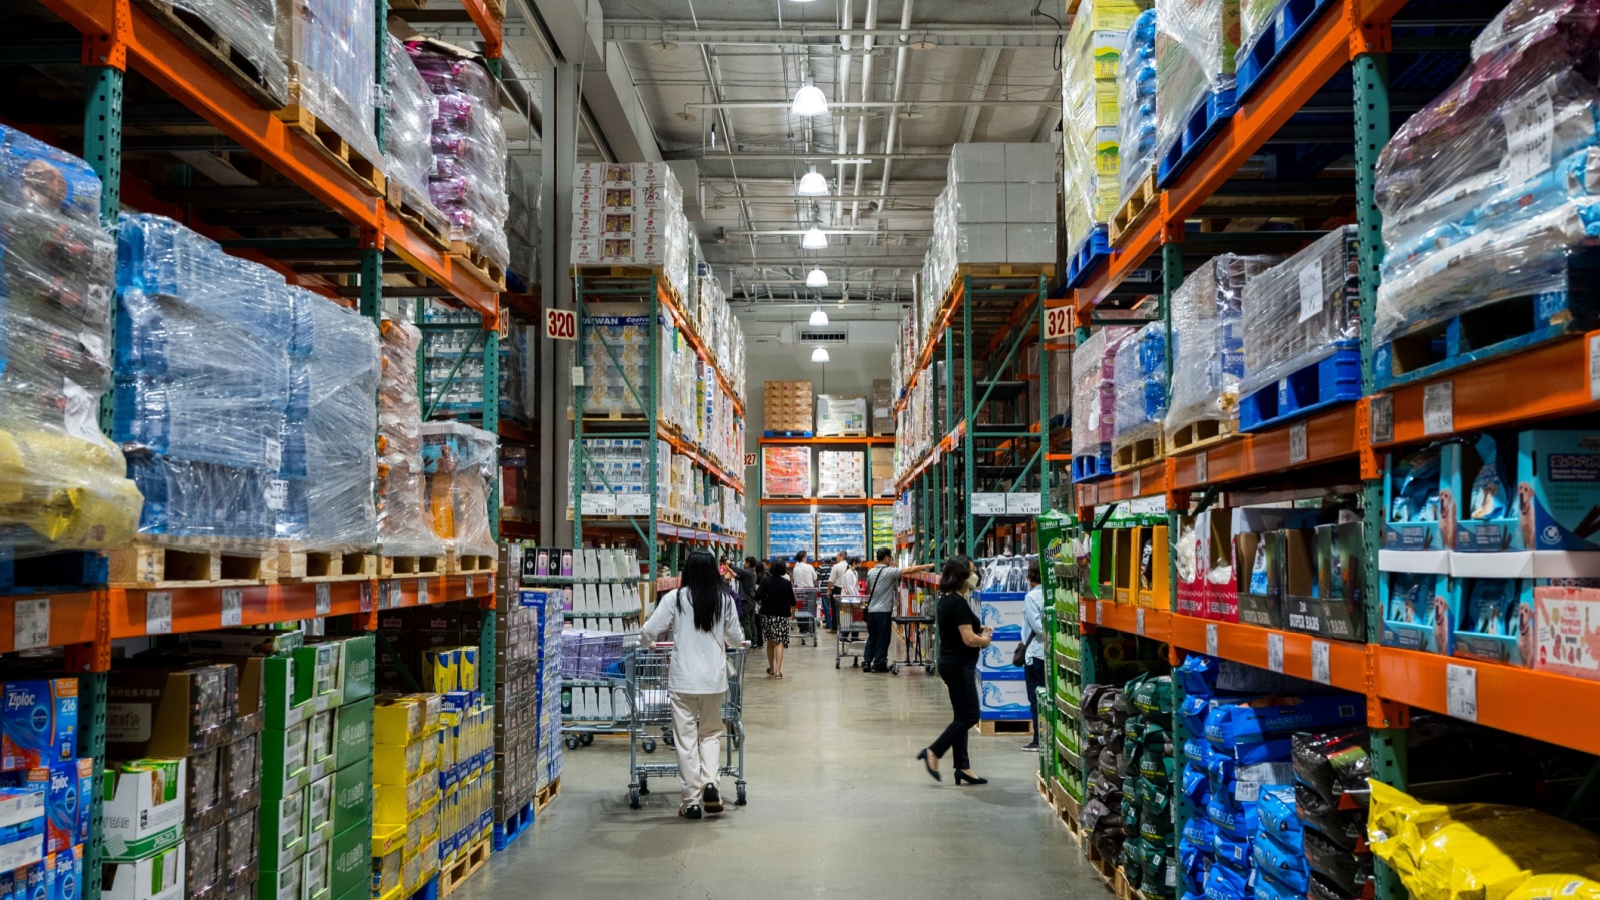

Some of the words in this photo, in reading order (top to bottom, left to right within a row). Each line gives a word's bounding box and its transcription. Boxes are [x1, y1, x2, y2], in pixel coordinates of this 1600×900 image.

[548, 310, 575, 338] 320
[1048, 308, 1071, 336] 321
[1243, 610, 1257, 623] SUPER
[1257, 611, 1270, 625] BARS
[1289, 614, 1305, 629] SUPER
[1305, 616, 1319, 631] BARS
[8, 692, 35, 710] Ziploc
[62, 699, 76, 712] 216
[1266, 716, 1293, 726] MATURE
[1296, 715, 1312, 723] DOG
[51, 774, 68, 792] Ziploc
[110, 816, 130, 828] BAG
[1221, 812, 1234, 825] DOG
[57, 860, 72, 874] Ziploc
[28, 870, 44, 886] Ziploc
